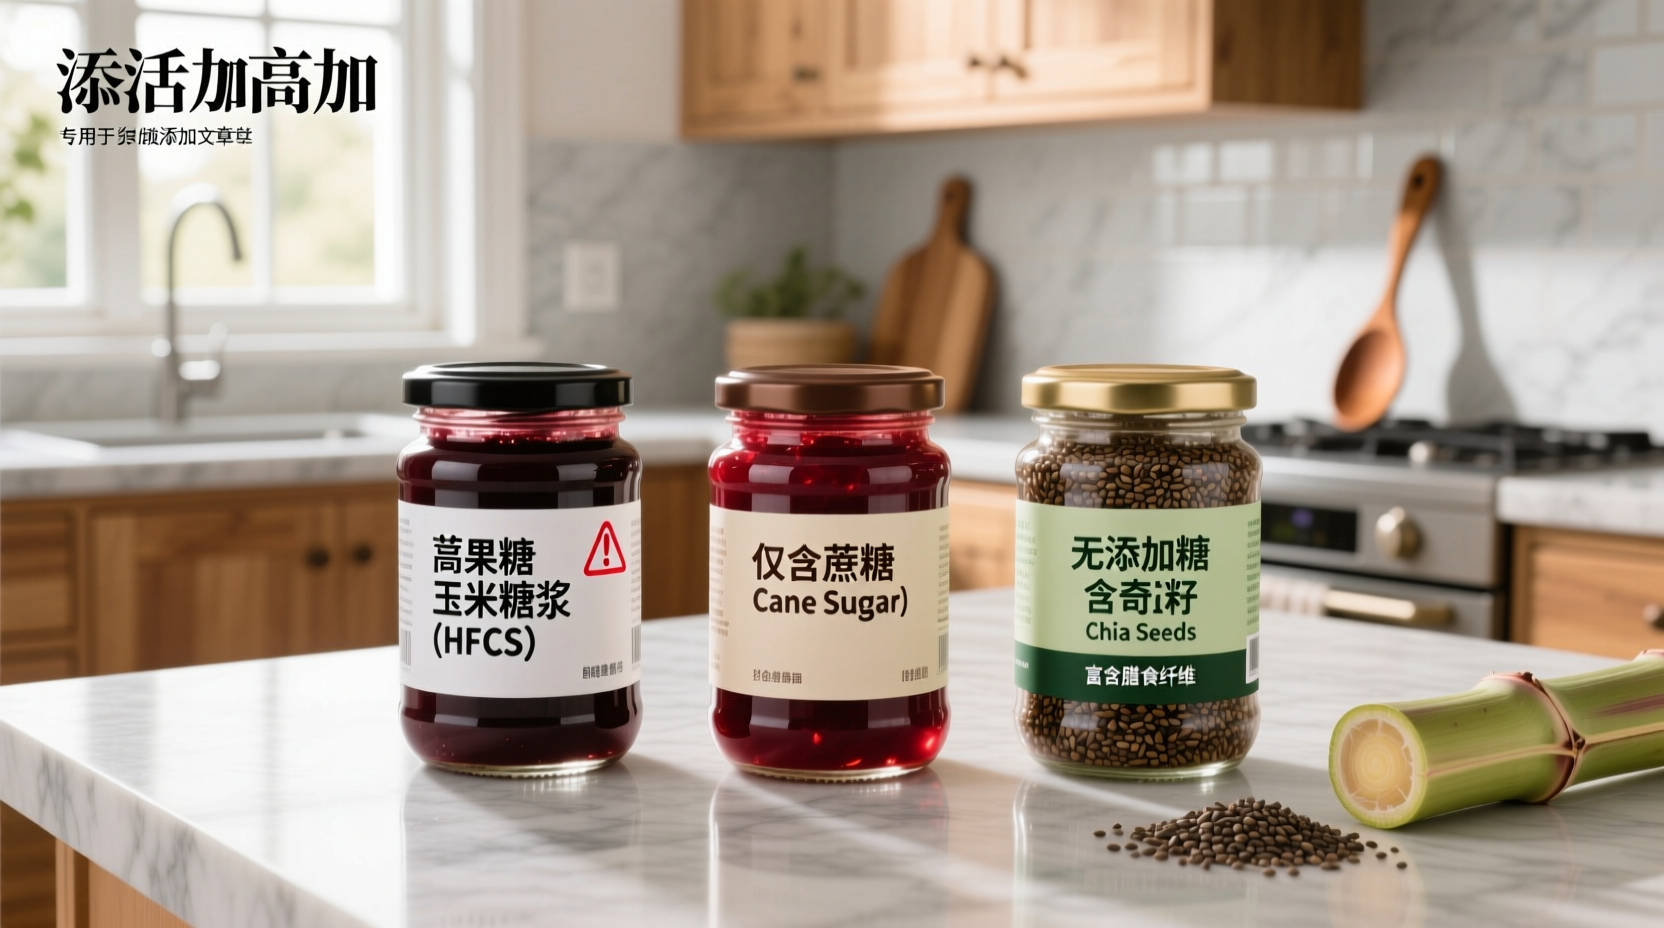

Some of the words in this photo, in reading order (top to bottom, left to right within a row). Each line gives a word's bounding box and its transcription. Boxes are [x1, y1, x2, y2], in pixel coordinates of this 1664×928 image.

[751, 542, 895, 583] 仅含蔗糖
[1071, 534, 1211, 573] 无添加糖
[432, 579, 571, 621] 玉米糖浆
[753, 587, 817, 615] Cane
[823, 585, 908, 622] Sugar)
[433, 621, 536, 662] (HFCS)
[1085, 621, 1131, 642] Chia
[1136, 621, 1197, 642] Seeds
